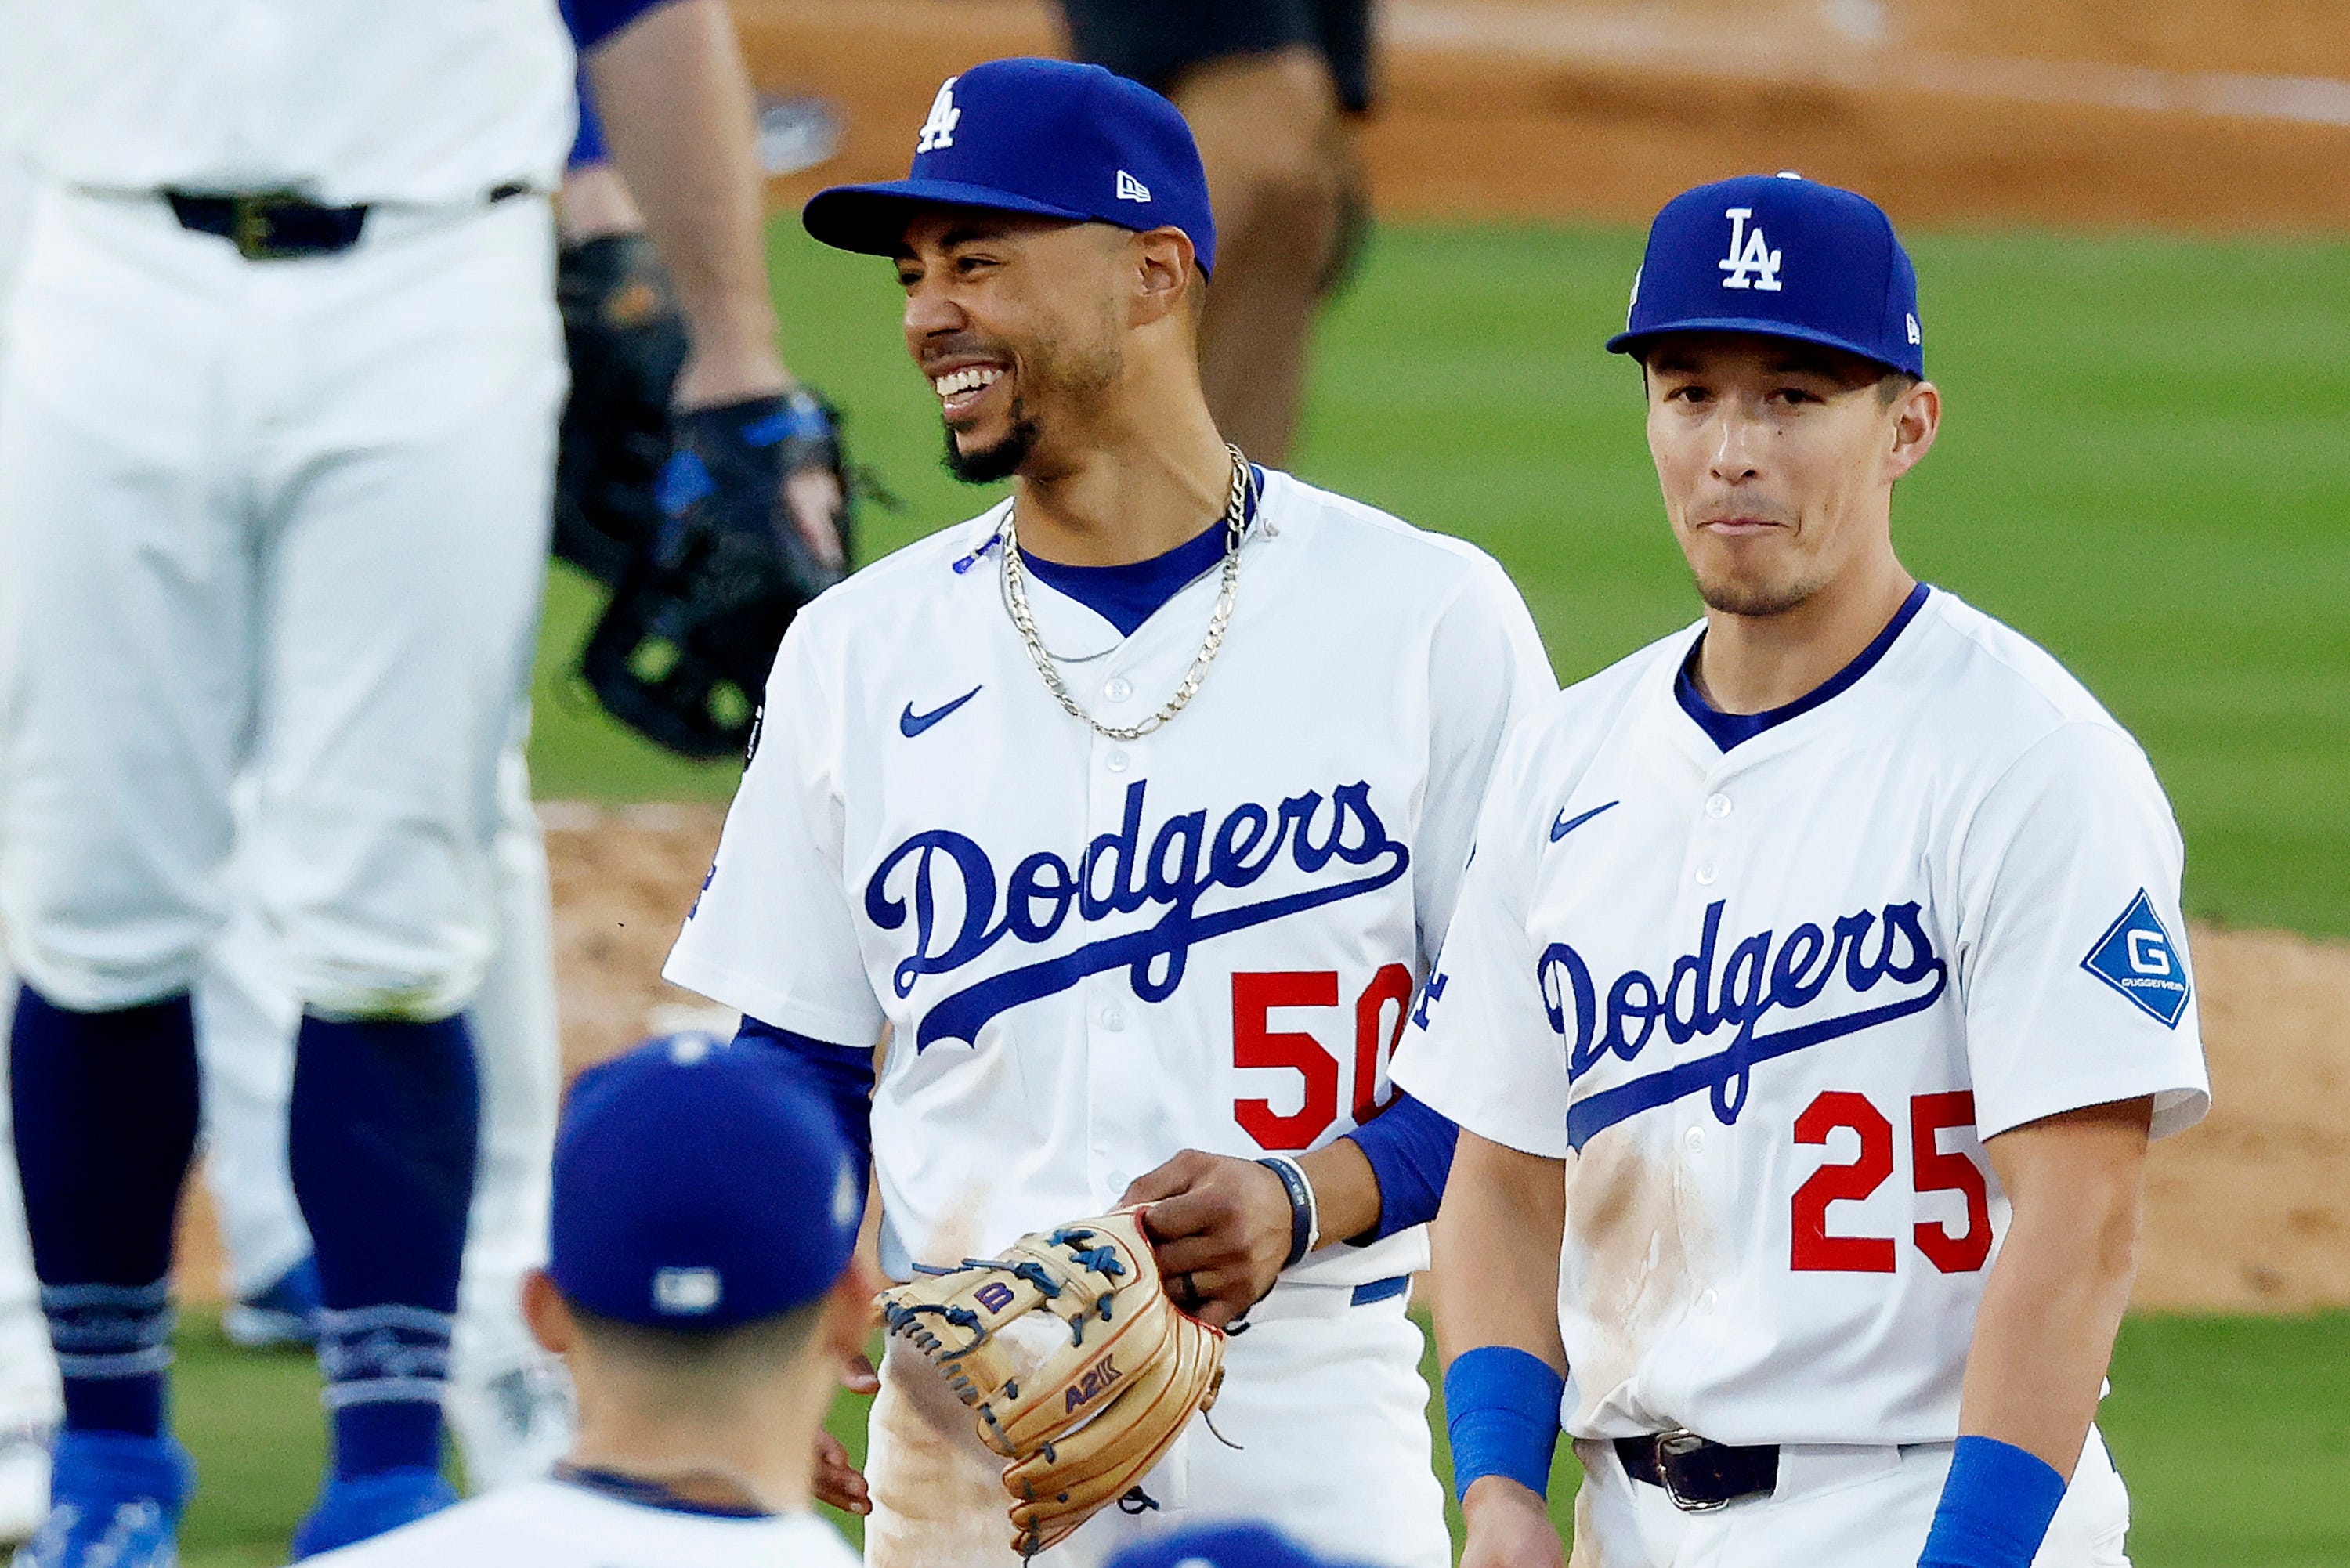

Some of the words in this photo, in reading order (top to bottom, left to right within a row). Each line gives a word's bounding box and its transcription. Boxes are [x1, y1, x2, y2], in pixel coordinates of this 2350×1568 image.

[1719, 208, 1782, 291] LA
[865, 779, 1410, 1056] Dodgers
[2127, 929, 2171, 976] G
[1231, 963, 1413, 1150] 50
[1537, 899, 1948, 1150] Dodgers
[1791, 1090, 1992, 1274] 25
[1065, 1353, 1123, 1414] A2K
